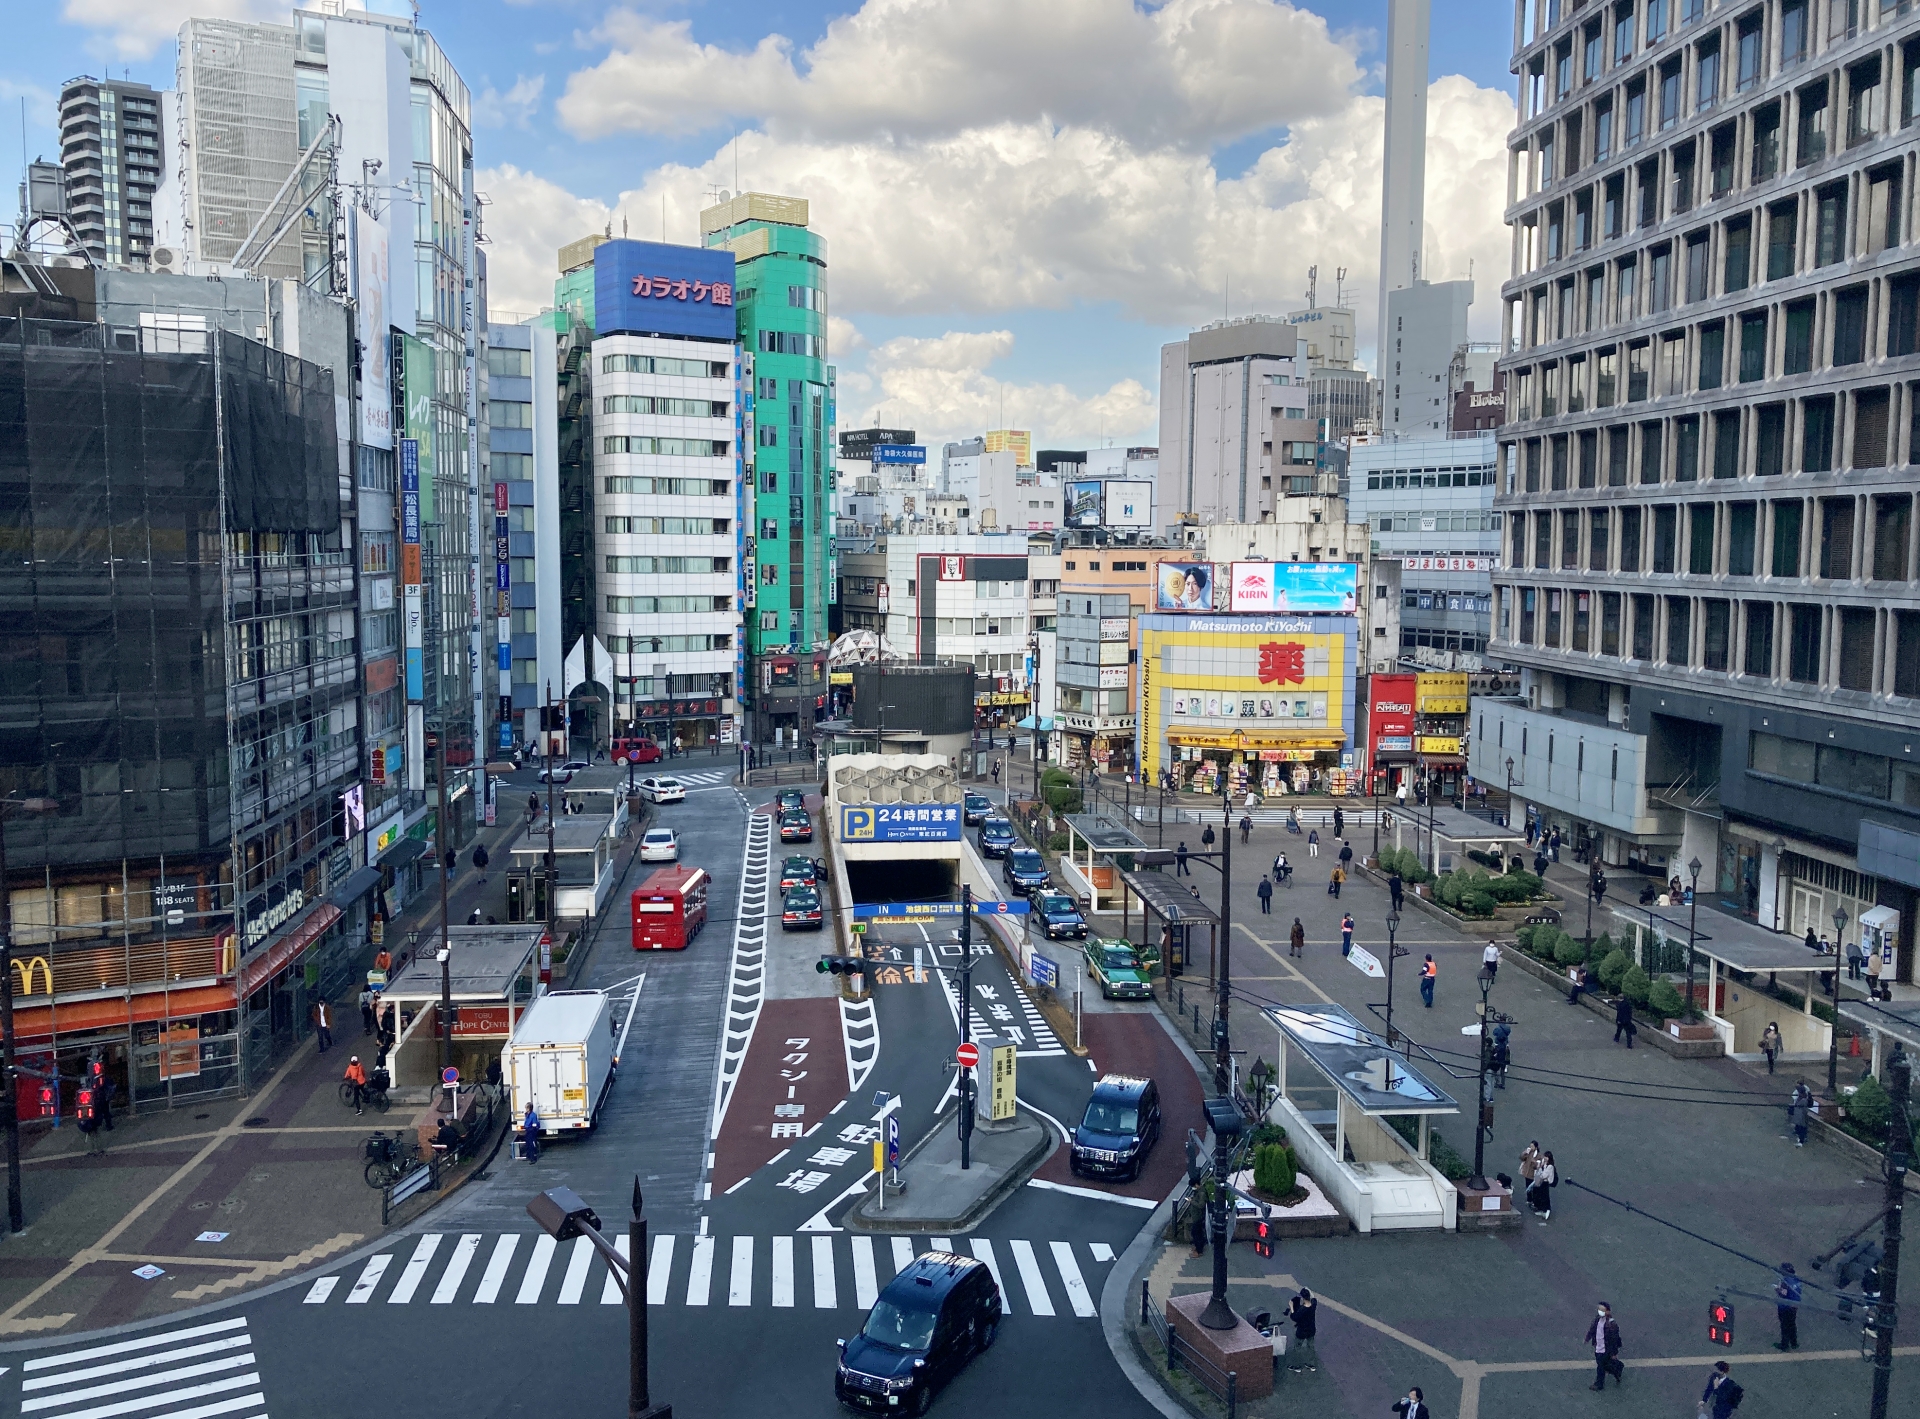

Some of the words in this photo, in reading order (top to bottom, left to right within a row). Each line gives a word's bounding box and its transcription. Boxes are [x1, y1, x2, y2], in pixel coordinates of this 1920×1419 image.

[632, 273, 733, 306] カラオケ館
[410, 390, 430, 425] レイク
[1470, 392, 1504, 408] Hotel
[404, 494, 418, 538] 松長薬局
[1238, 590, 1268, 598] KIRIN
[1189, 620, 1262, 632] Matsumoto
[1264, 620, 1312, 632] KiYoshi
[1258, 642, 1306, 686] 薬
[642, 700, 717, 717] カラオケ館
[848, 810, 870, 836] P
[878, 808, 957, 822] 24時間営業
[248, 888, 303, 946] McDonald's
[879, 906, 889, 914] IN
[771, 1038, 810, 1138] タクシー専用
[889, 1117, 898, 1144] P
[776, 1123, 880, 1194] 駐車場
